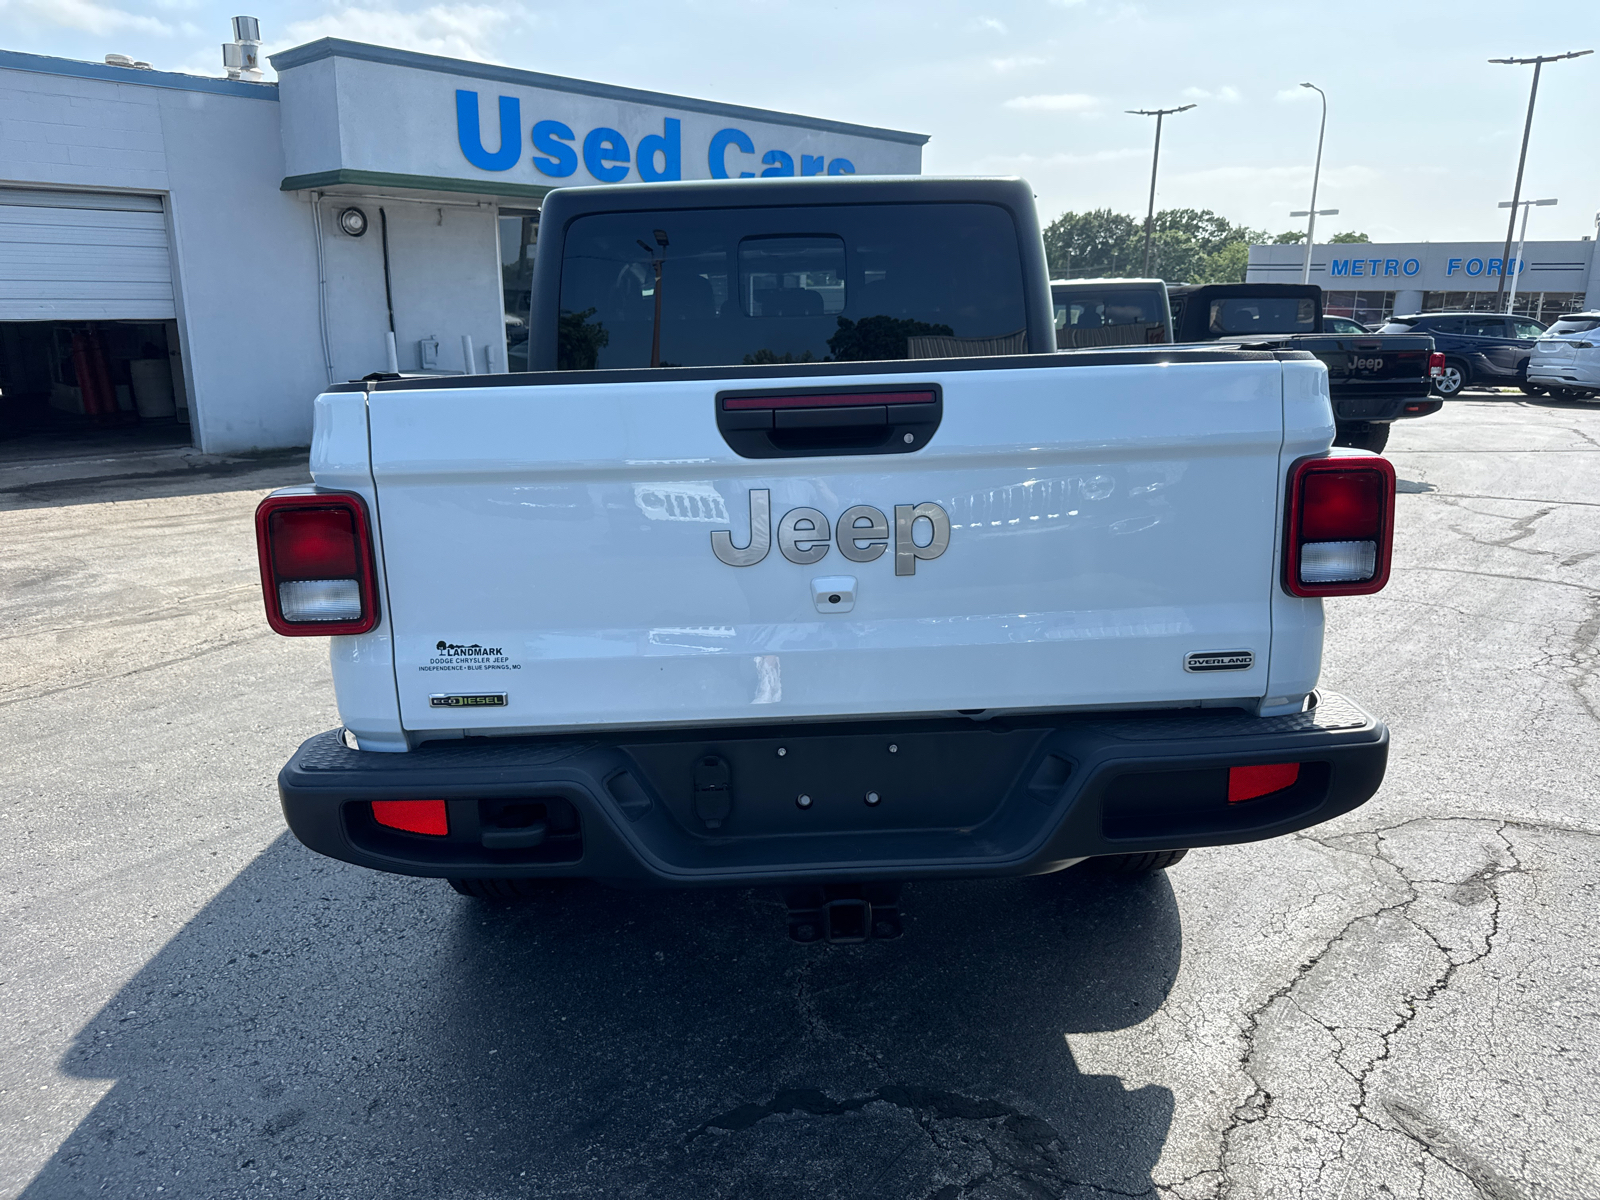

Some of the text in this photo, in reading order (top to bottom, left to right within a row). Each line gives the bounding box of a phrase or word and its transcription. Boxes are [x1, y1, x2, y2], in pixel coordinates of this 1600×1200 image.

[455, 89, 682, 183] Used
[1330, 257, 1525, 277] METRO FORD
[1347, 355, 1383, 372] Jeep
[710, 488, 951, 576] Jeep
[447, 647, 503, 657] LANDMARK
[429, 657, 454, 665] DODGE
[455, 656, 491, 664] CHRYSLER
[1188, 657, 1253, 666] OVERLAND
[418, 664, 464, 672] INDEPENDENCE
[484, 663, 512, 671] SPRINGS,
